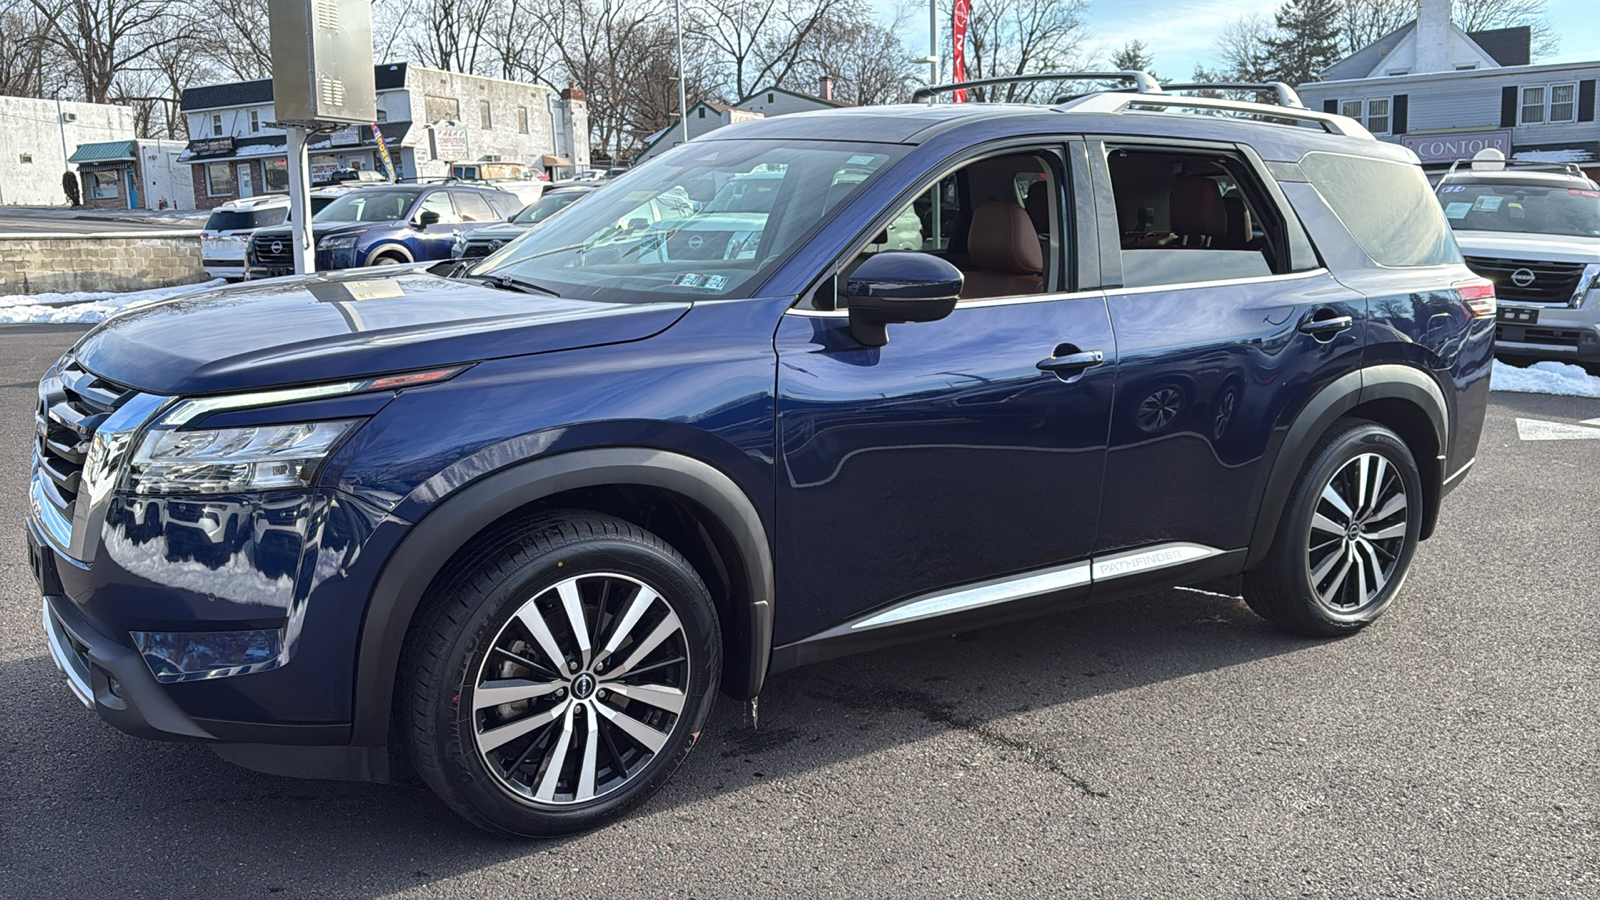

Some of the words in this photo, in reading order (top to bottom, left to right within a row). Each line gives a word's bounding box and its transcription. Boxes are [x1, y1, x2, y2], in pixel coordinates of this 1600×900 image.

[437, 137, 466, 145] COMPUTERS
[312, 164, 339, 174] COMPUTERS
[1099, 550, 1182, 574] PATHFINDER
